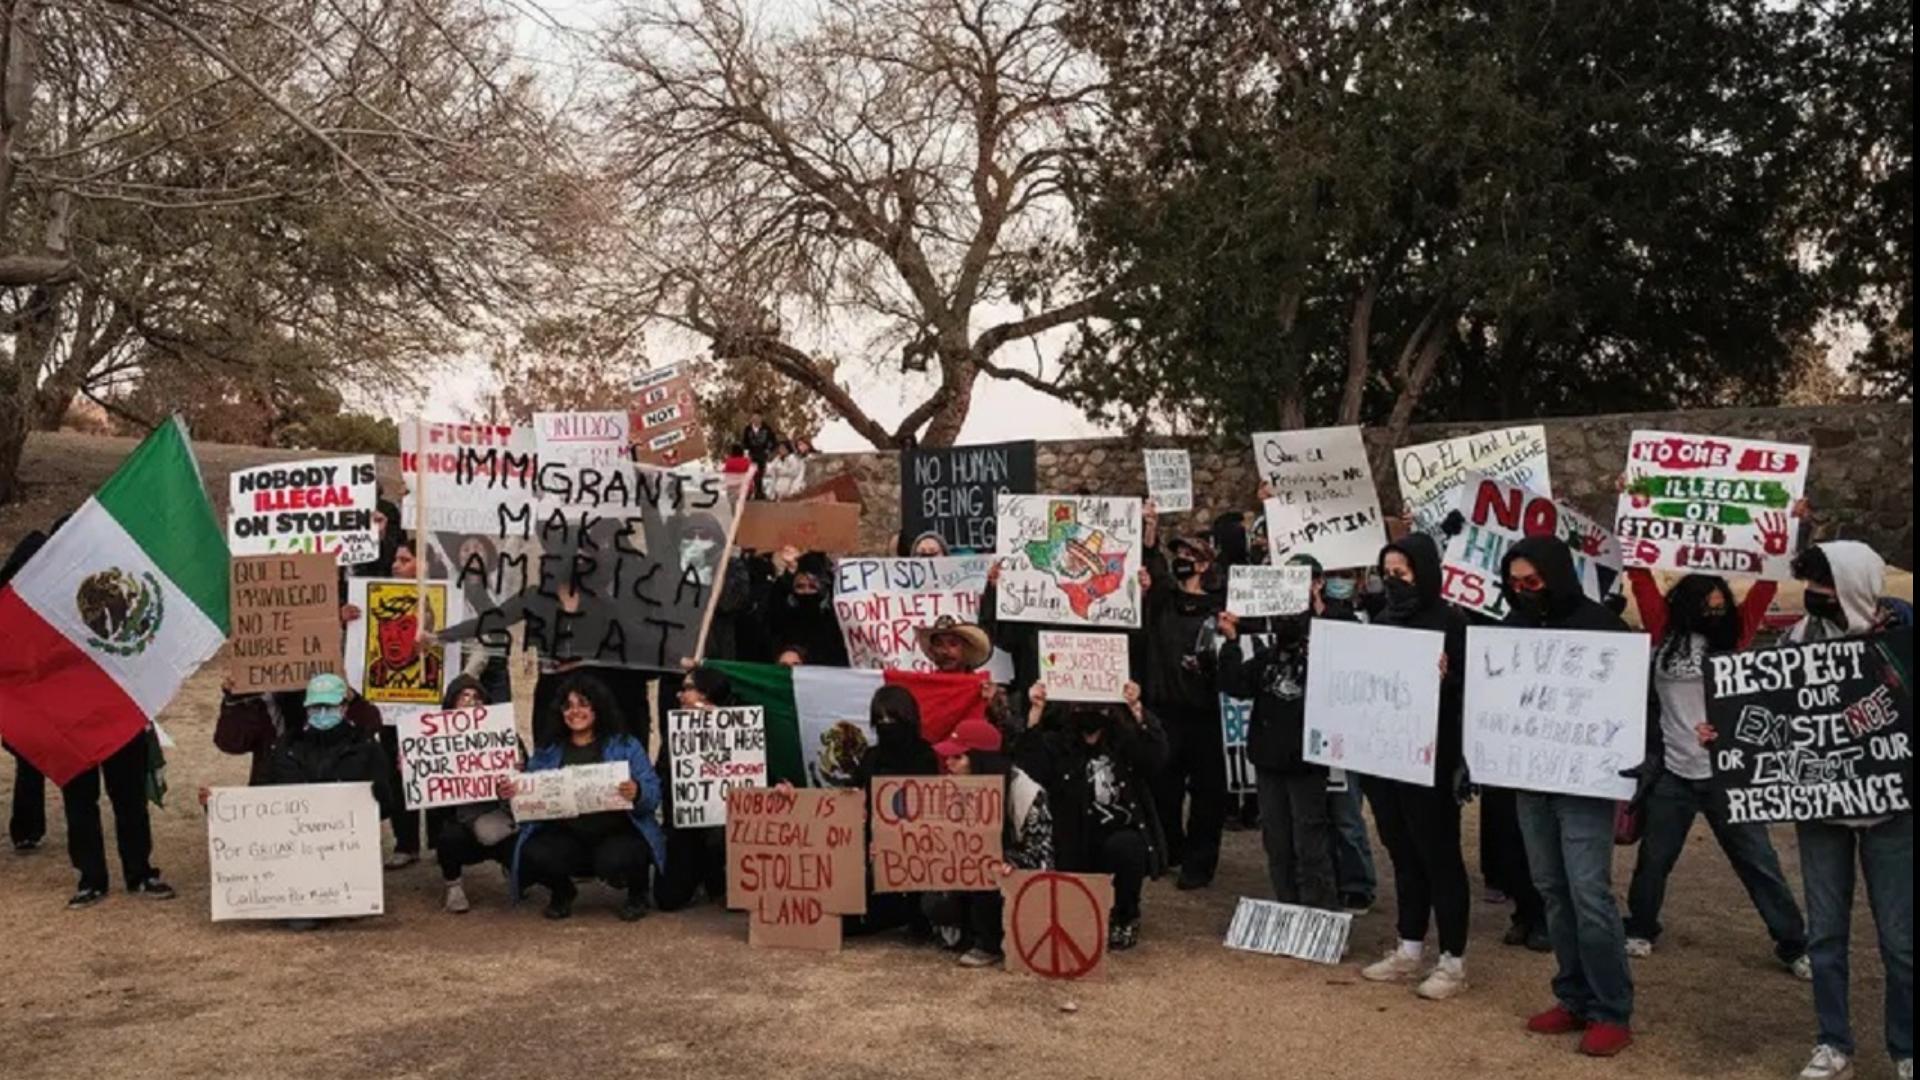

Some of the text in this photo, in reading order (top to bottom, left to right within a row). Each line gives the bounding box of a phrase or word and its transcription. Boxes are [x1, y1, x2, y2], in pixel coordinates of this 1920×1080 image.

[646, 407, 675, 425] NOT
[430, 424, 511, 446] FIGHT
[914, 448, 1008, 485] NO HUMAN
[1638, 443, 1787, 470] NO ONE IS
[239, 463, 375, 494] NOBODY IS
[456, 446, 721, 509] IMMIGRANTS
[1664, 478, 1766, 501] ILLEGAL
[254, 485, 353, 512] ILLEGAL
[922, 485, 984, 518] BEING
[1472, 479, 1558, 541] NO
[1685, 502, 1720, 523] ON
[235, 508, 371, 537] ON STOLEN
[498, 502, 646, 558] MAKE
[1620, 518, 1715, 544] STOLEN
[280, 560, 300, 581] EL
[1688, 548, 1752, 571] LAND
[456, 552, 702, 609] AMERICA
[1442, 564, 1486, 608] IS
[900, 593, 943, 618] LET
[238, 611, 293, 635] NO TE
[475, 607, 686, 668] GREAT
[303, 636, 321, 656] LA
[1710, 640, 1867, 699] RESPECT
[1797, 684, 1841, 711] OUR
[421, 705, 488, 736] STOP
[671, 709, 761, 730] THE ONLY
[402, 728, 516, 757] PRETENDING
[734, 728, 766, 752] HERE
[1718, 748, 1746, 771] OR
[1869, 732, 1914, 761] OUR
[406, 749, 516, 784] YOUR RACISM
[675, 759, 694, 779] IS
[406, 781, 422, 804] IS
[675, 780, 714, 803] NOT
[728, 791, 836, 818] NOBODY IS
[1726, 772, 1912, 824] RESISTANCE
[730, 820, 852, 849] ILLEGAL ON
[899, 823, 983, 855] has no
[740, 853, 833, 892] STOLEN
[758, 896, 823, 926] LAND
